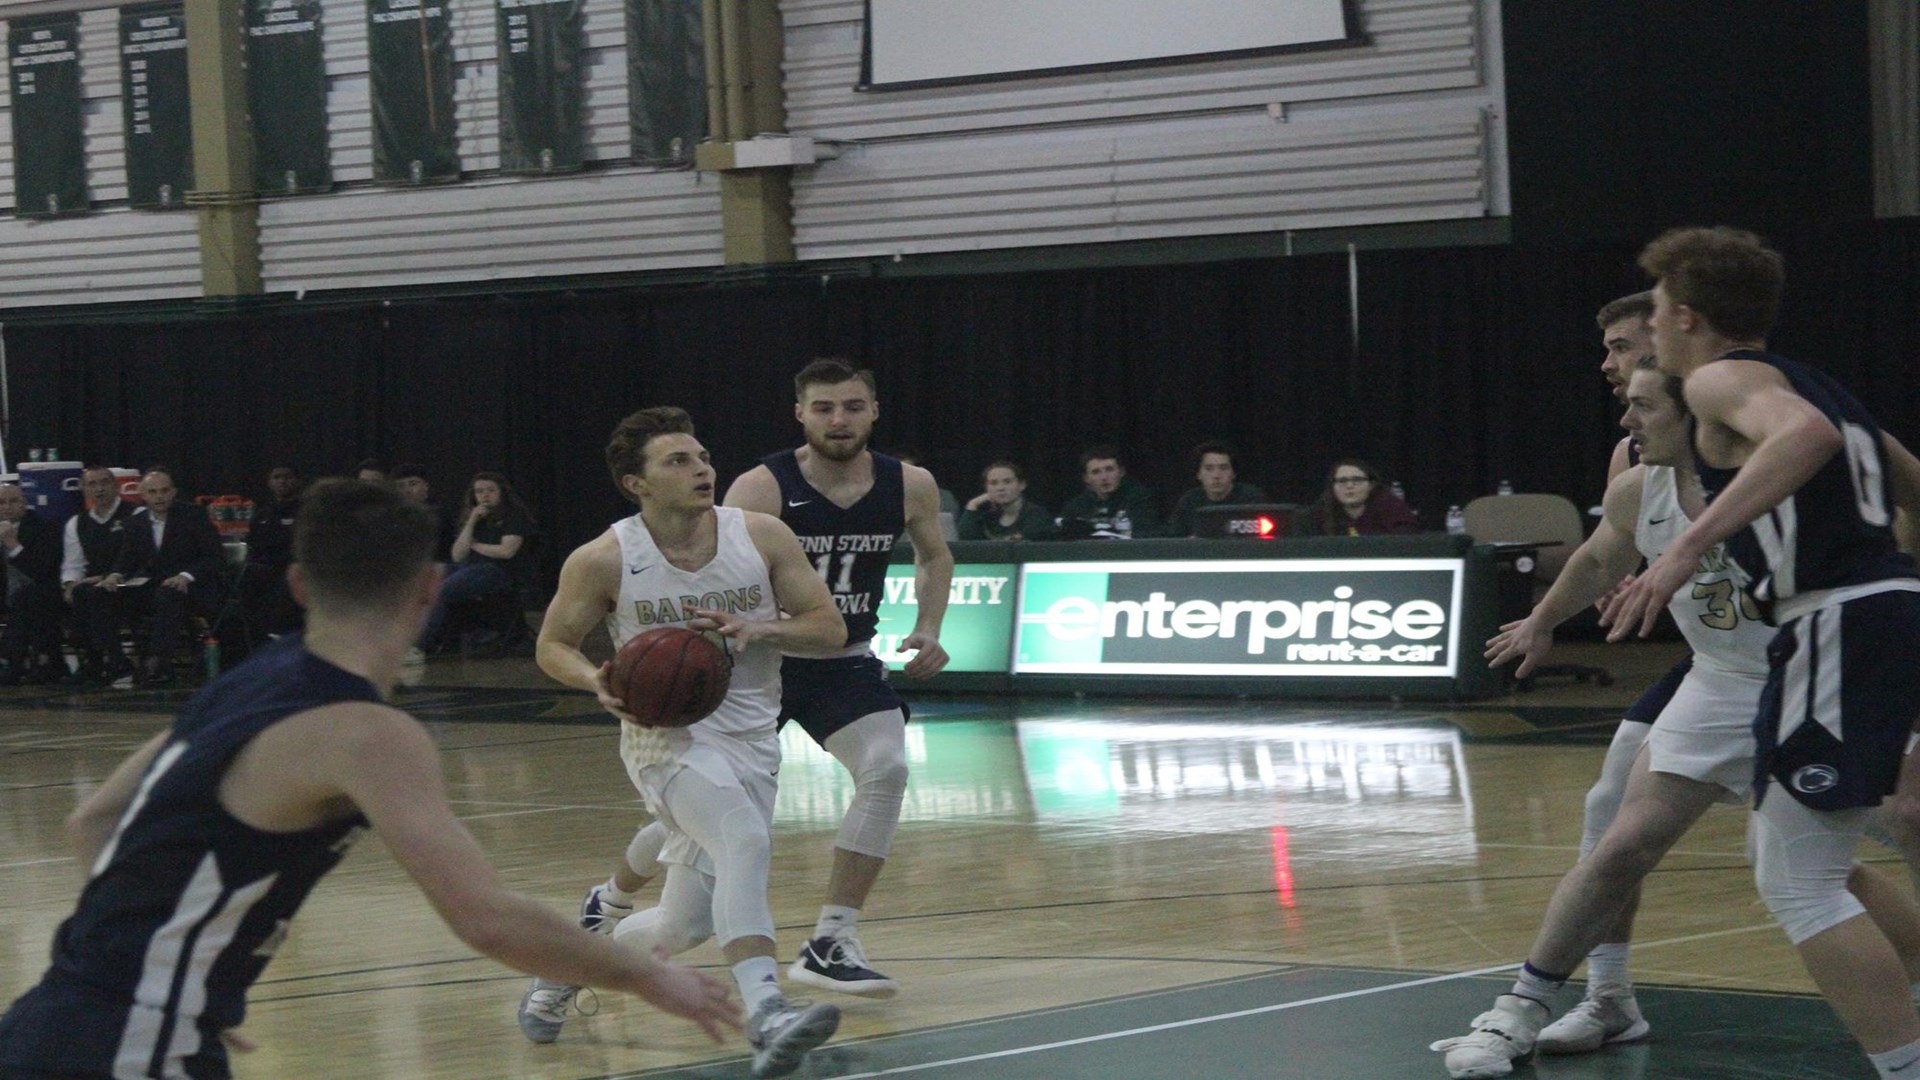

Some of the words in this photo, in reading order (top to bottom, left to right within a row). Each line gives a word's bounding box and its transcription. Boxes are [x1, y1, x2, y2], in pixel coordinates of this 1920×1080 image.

[837, 534, 894, 552] STATE
[815, 553, 857, 592] 11
[634, 584, 763, 625] BARONS
[1045, 586, 1445, 655] enterprise
[1286, 640, 1443, 662] rent-a-car
